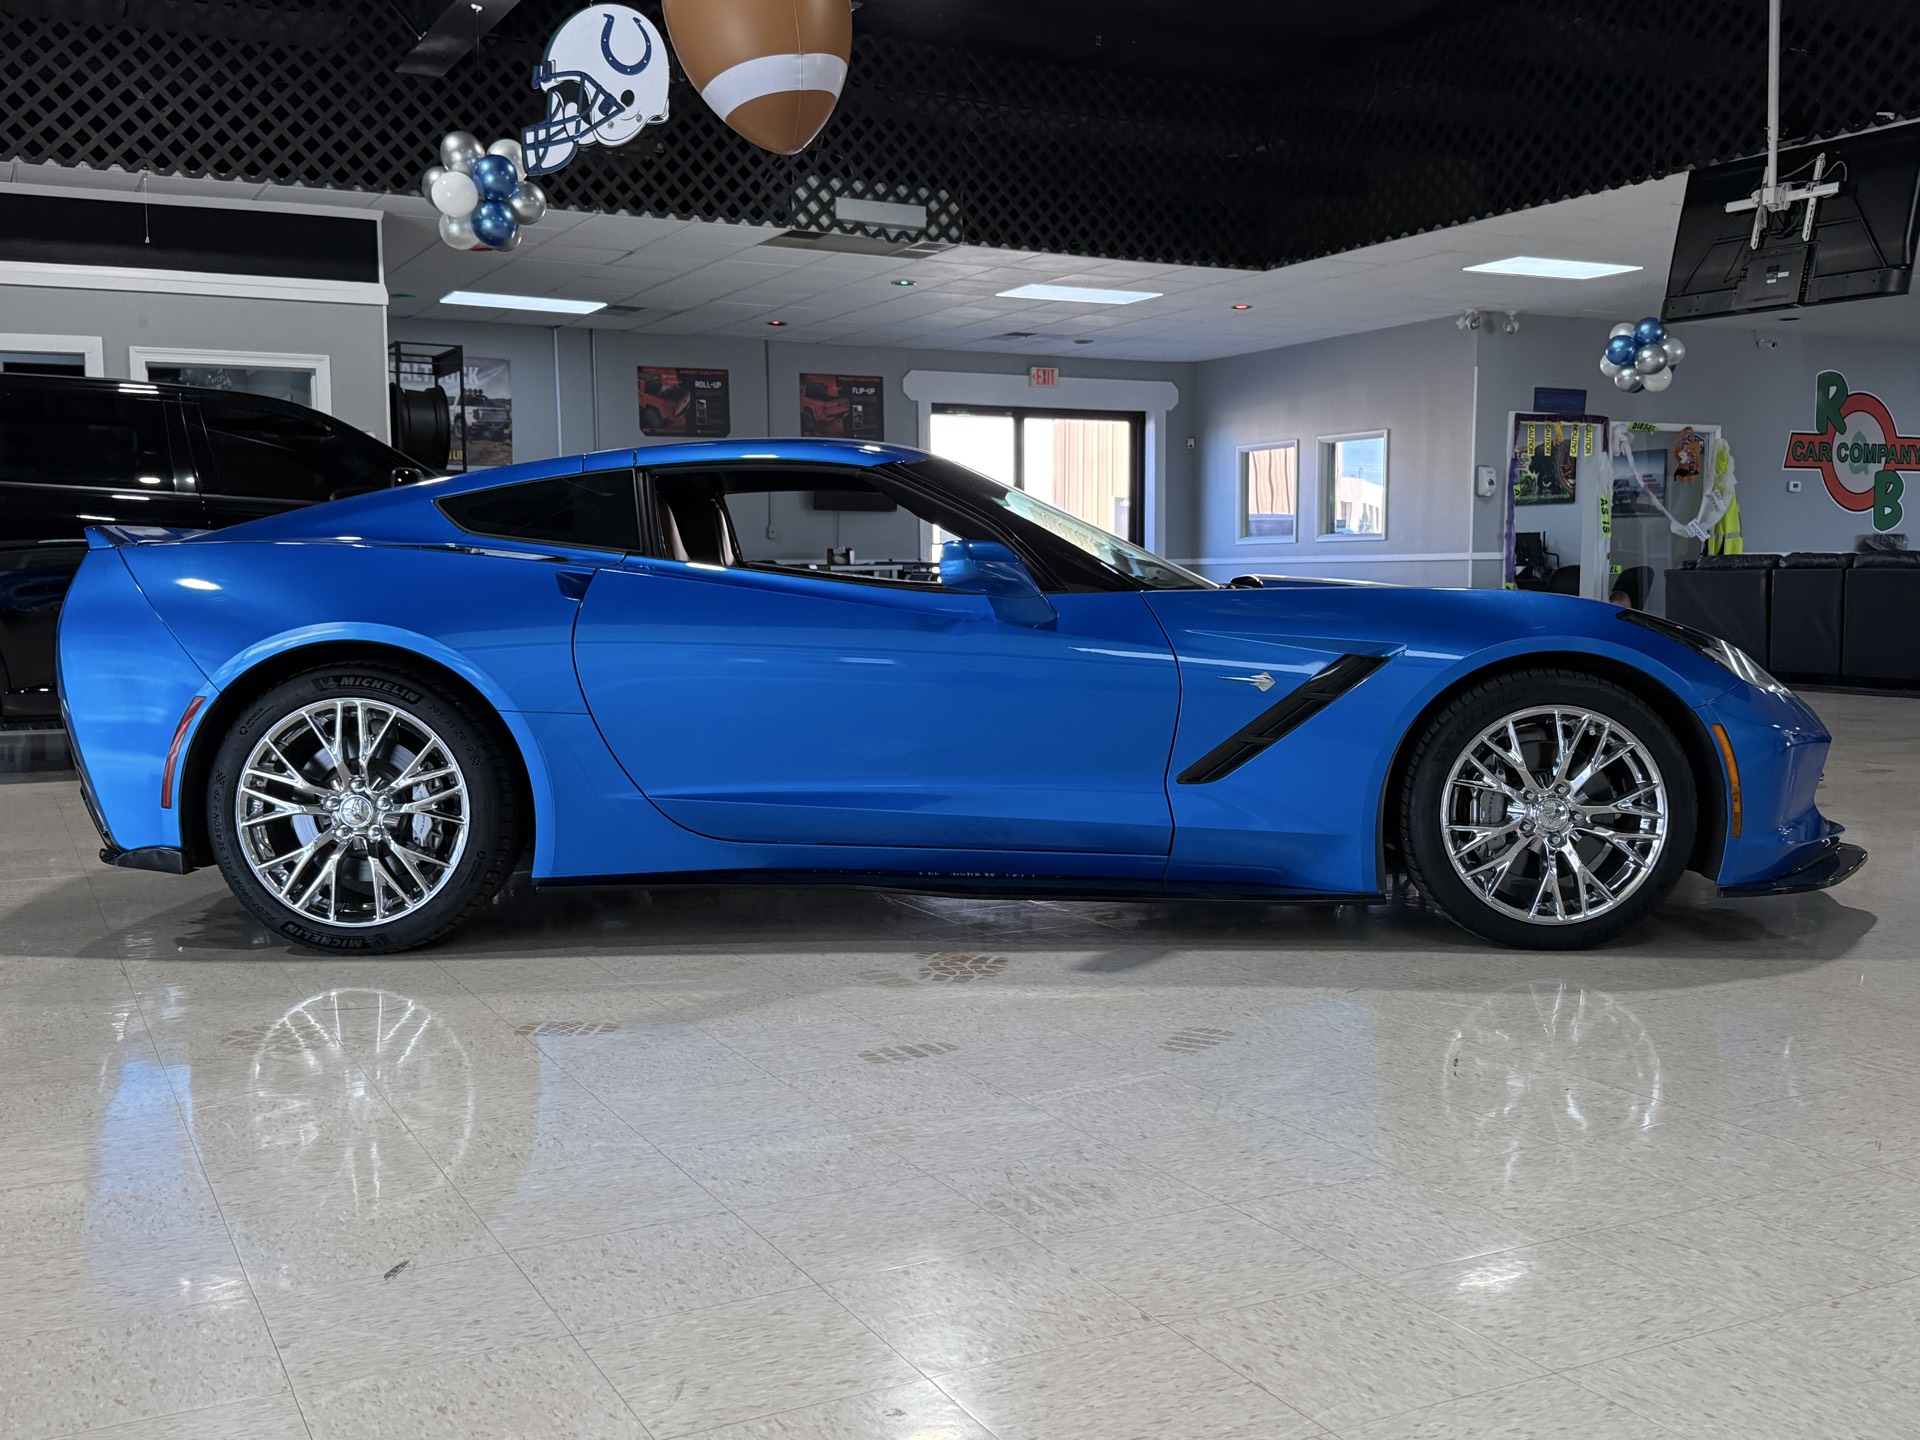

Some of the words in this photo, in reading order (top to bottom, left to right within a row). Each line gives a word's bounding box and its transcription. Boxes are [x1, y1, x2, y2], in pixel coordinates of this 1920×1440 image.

[694, 381, 721, 389] ROLL-UP
[1035, 368, 1055, 386] EXIT
[1792, 441, 1832, 462] CAR
[1836, 442, 1920, 465] COMPANY
[1815, 370, 1849, 435] R
[1874, 470, 1903, 531] B
[1600, 498, 1609, 515] AS
[1602, 521, 1610, 533] IS
[340, 677, 420, 701] MICHELIN
[213, 813, 225, 851] SEASON
[222, 856, 233, 871] ALL
[230, 874, 253, 900] SPORT
[251, 899, 275, 922] PILOT
[283, 924, 363, 947] MICHELIN
